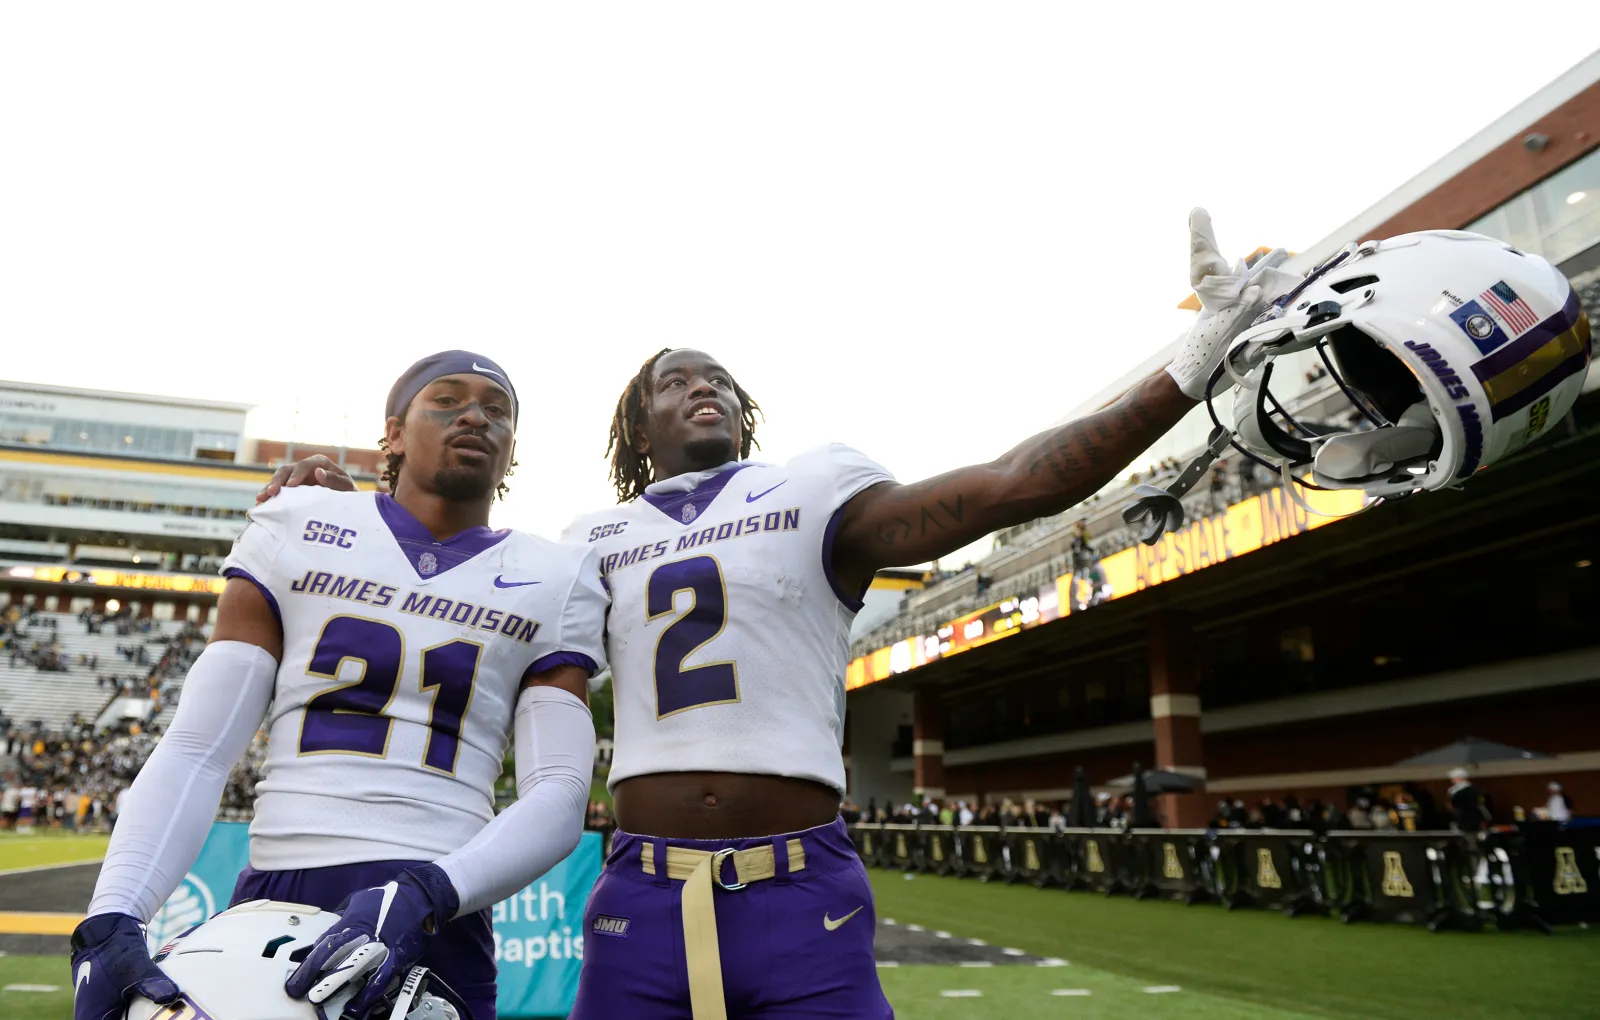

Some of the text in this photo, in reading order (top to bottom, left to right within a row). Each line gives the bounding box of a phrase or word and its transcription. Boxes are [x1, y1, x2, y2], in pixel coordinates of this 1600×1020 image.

[1403, 340, 1470, 400] JAMES
[303, 520, 357, 549] SBC
[588, 521, 629, 543] SBC
[674, 507, 801, 553] MADISON
[290, 570, 542, 644] JAMES MADISON
[645, 553, 741, 721] 2
[297, 612, 484, 778] 21
[594, 917, 628, 935] JMU
